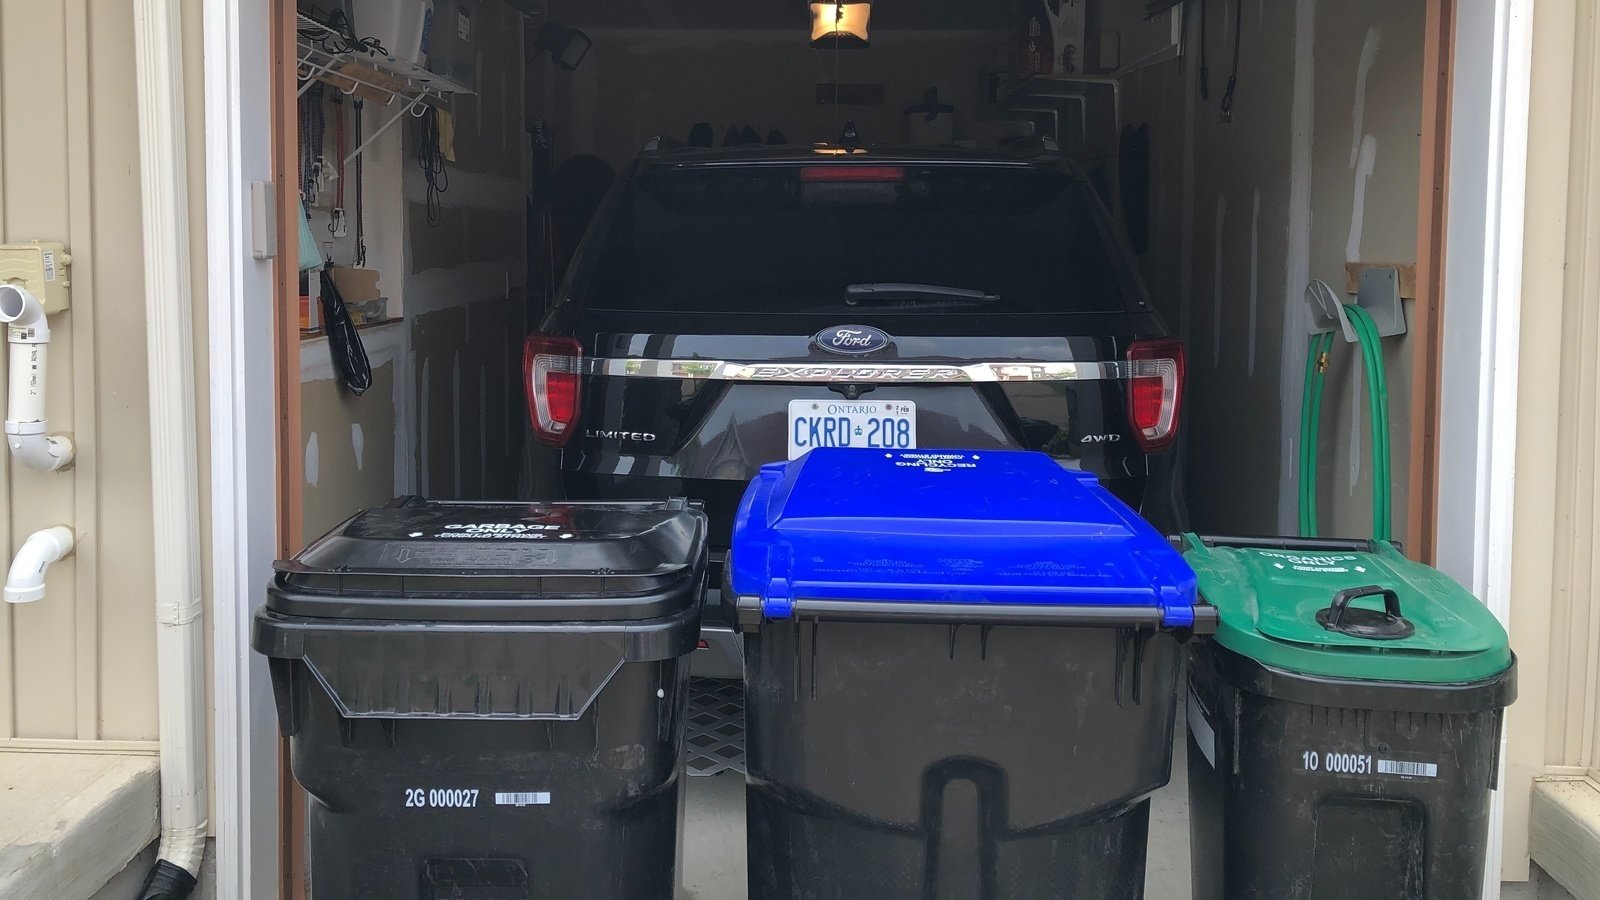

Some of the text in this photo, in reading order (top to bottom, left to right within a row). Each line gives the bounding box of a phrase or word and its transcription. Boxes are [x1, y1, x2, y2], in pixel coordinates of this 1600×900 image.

[832, 329, 872, 347] Ford
[753, 366, 960, 380] EXPLORER
[827, 404, 877, 415] ONTARIO
[586, 429, 656, 441] LIMITED
[794, 416, 910, 448] CKRD 208
[1081, 434, 1120, 443] 4WD
[1259, 551, 1357, 561] ORGANICS
[1288, 558, 1336, 566] ONLY
[1325, 753, 1372, 774] 000051
[405, 788, 479, 807] 2G 000027
